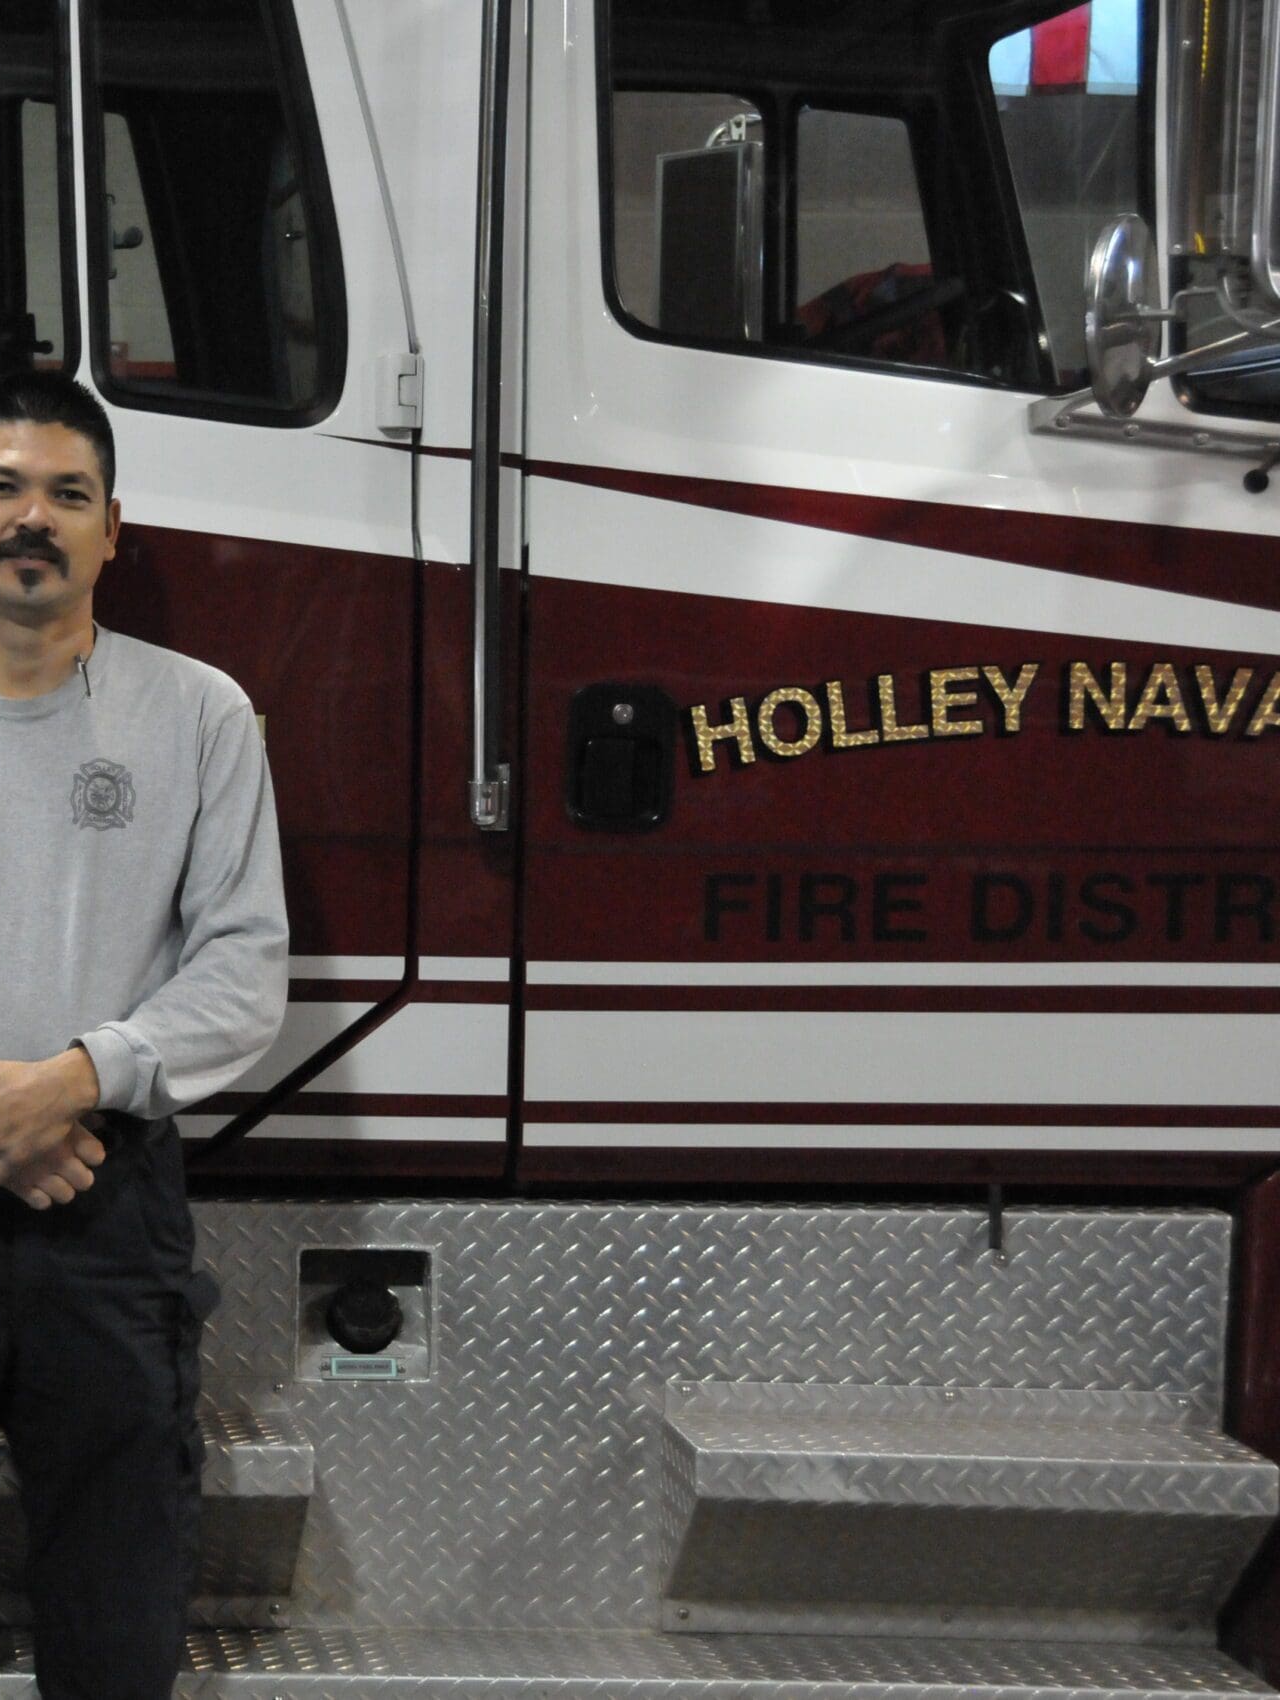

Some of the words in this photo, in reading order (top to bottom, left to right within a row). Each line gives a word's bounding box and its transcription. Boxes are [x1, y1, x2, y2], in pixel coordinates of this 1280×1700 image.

[691, 664, 1040, 772] HOLLEY
[704, 872, 928, 943] FIRE
[972, 872, 1280, 943] DISTR
